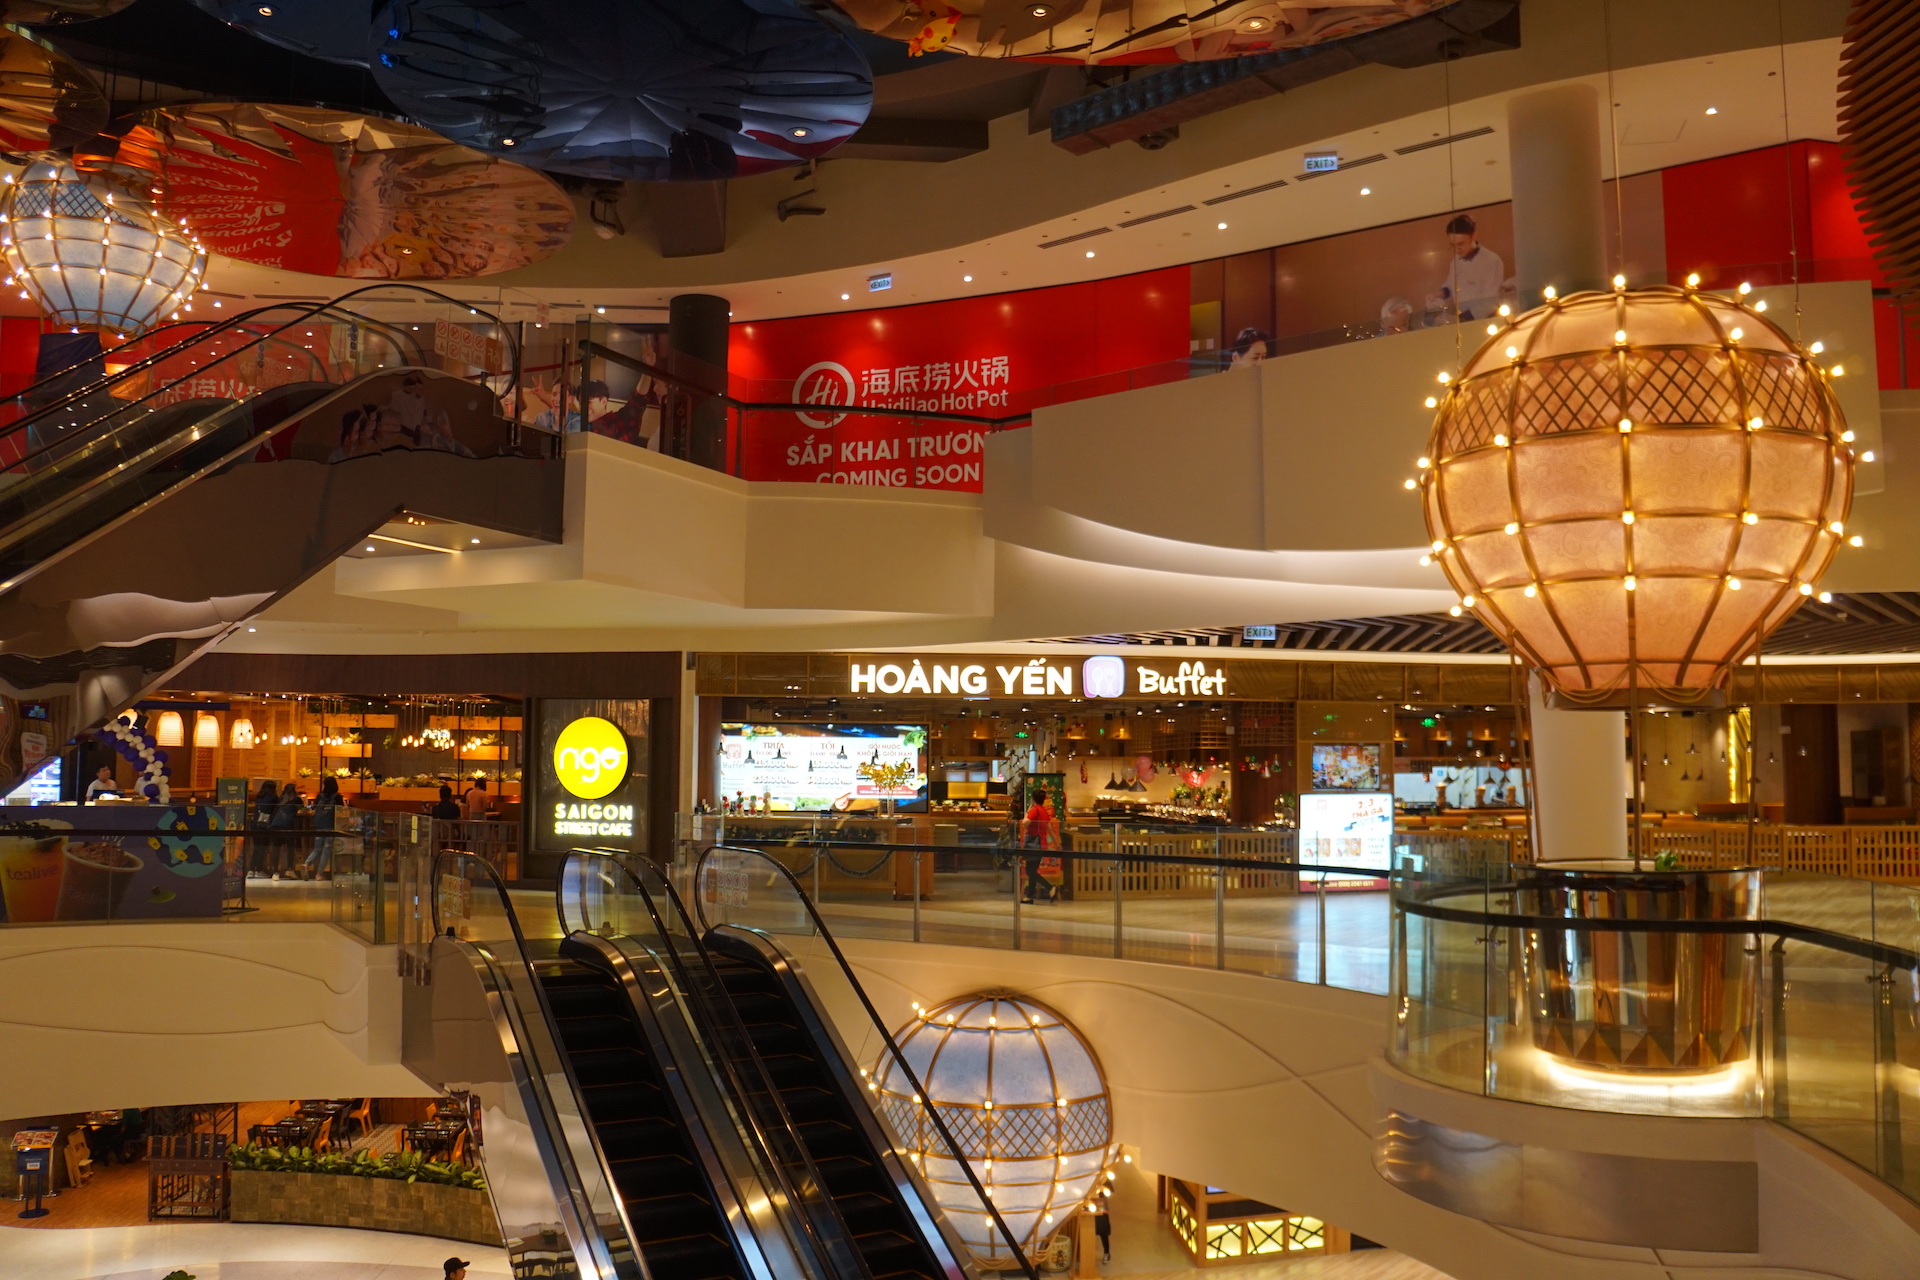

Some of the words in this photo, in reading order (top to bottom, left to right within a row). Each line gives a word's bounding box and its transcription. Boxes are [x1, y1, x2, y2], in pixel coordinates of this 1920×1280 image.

[1306, 158, 1329, 169] EXIT
[873, 279, 887, 290] EXIT
[861, 356, 1009, 398] 海底捞火锅
[941, 393, 974, 411] Hot
[977, 390, 1009, 408] Pot
[786, 434, 833, 466] SẮP
[841, 438, 900, 463] KHAI
[907, 429, 991, 458] TRƯƠN
[816, 466, 908, 488] COMING
[915, 462, 980, 486] SOON
[1246, 627, 1267, 638] EXIT
[849, 658, 988, 695] HOÀNG
[995, 657, 1073, 695] YẾN
[1136, 661, 1228, 696] Buffet
[554, 803, 634, 820] SAIGON
[554, 821, 598, 836] STREET
[598, 822, 633, 837] CAFE
[6, 864, 59, 880] tealive
